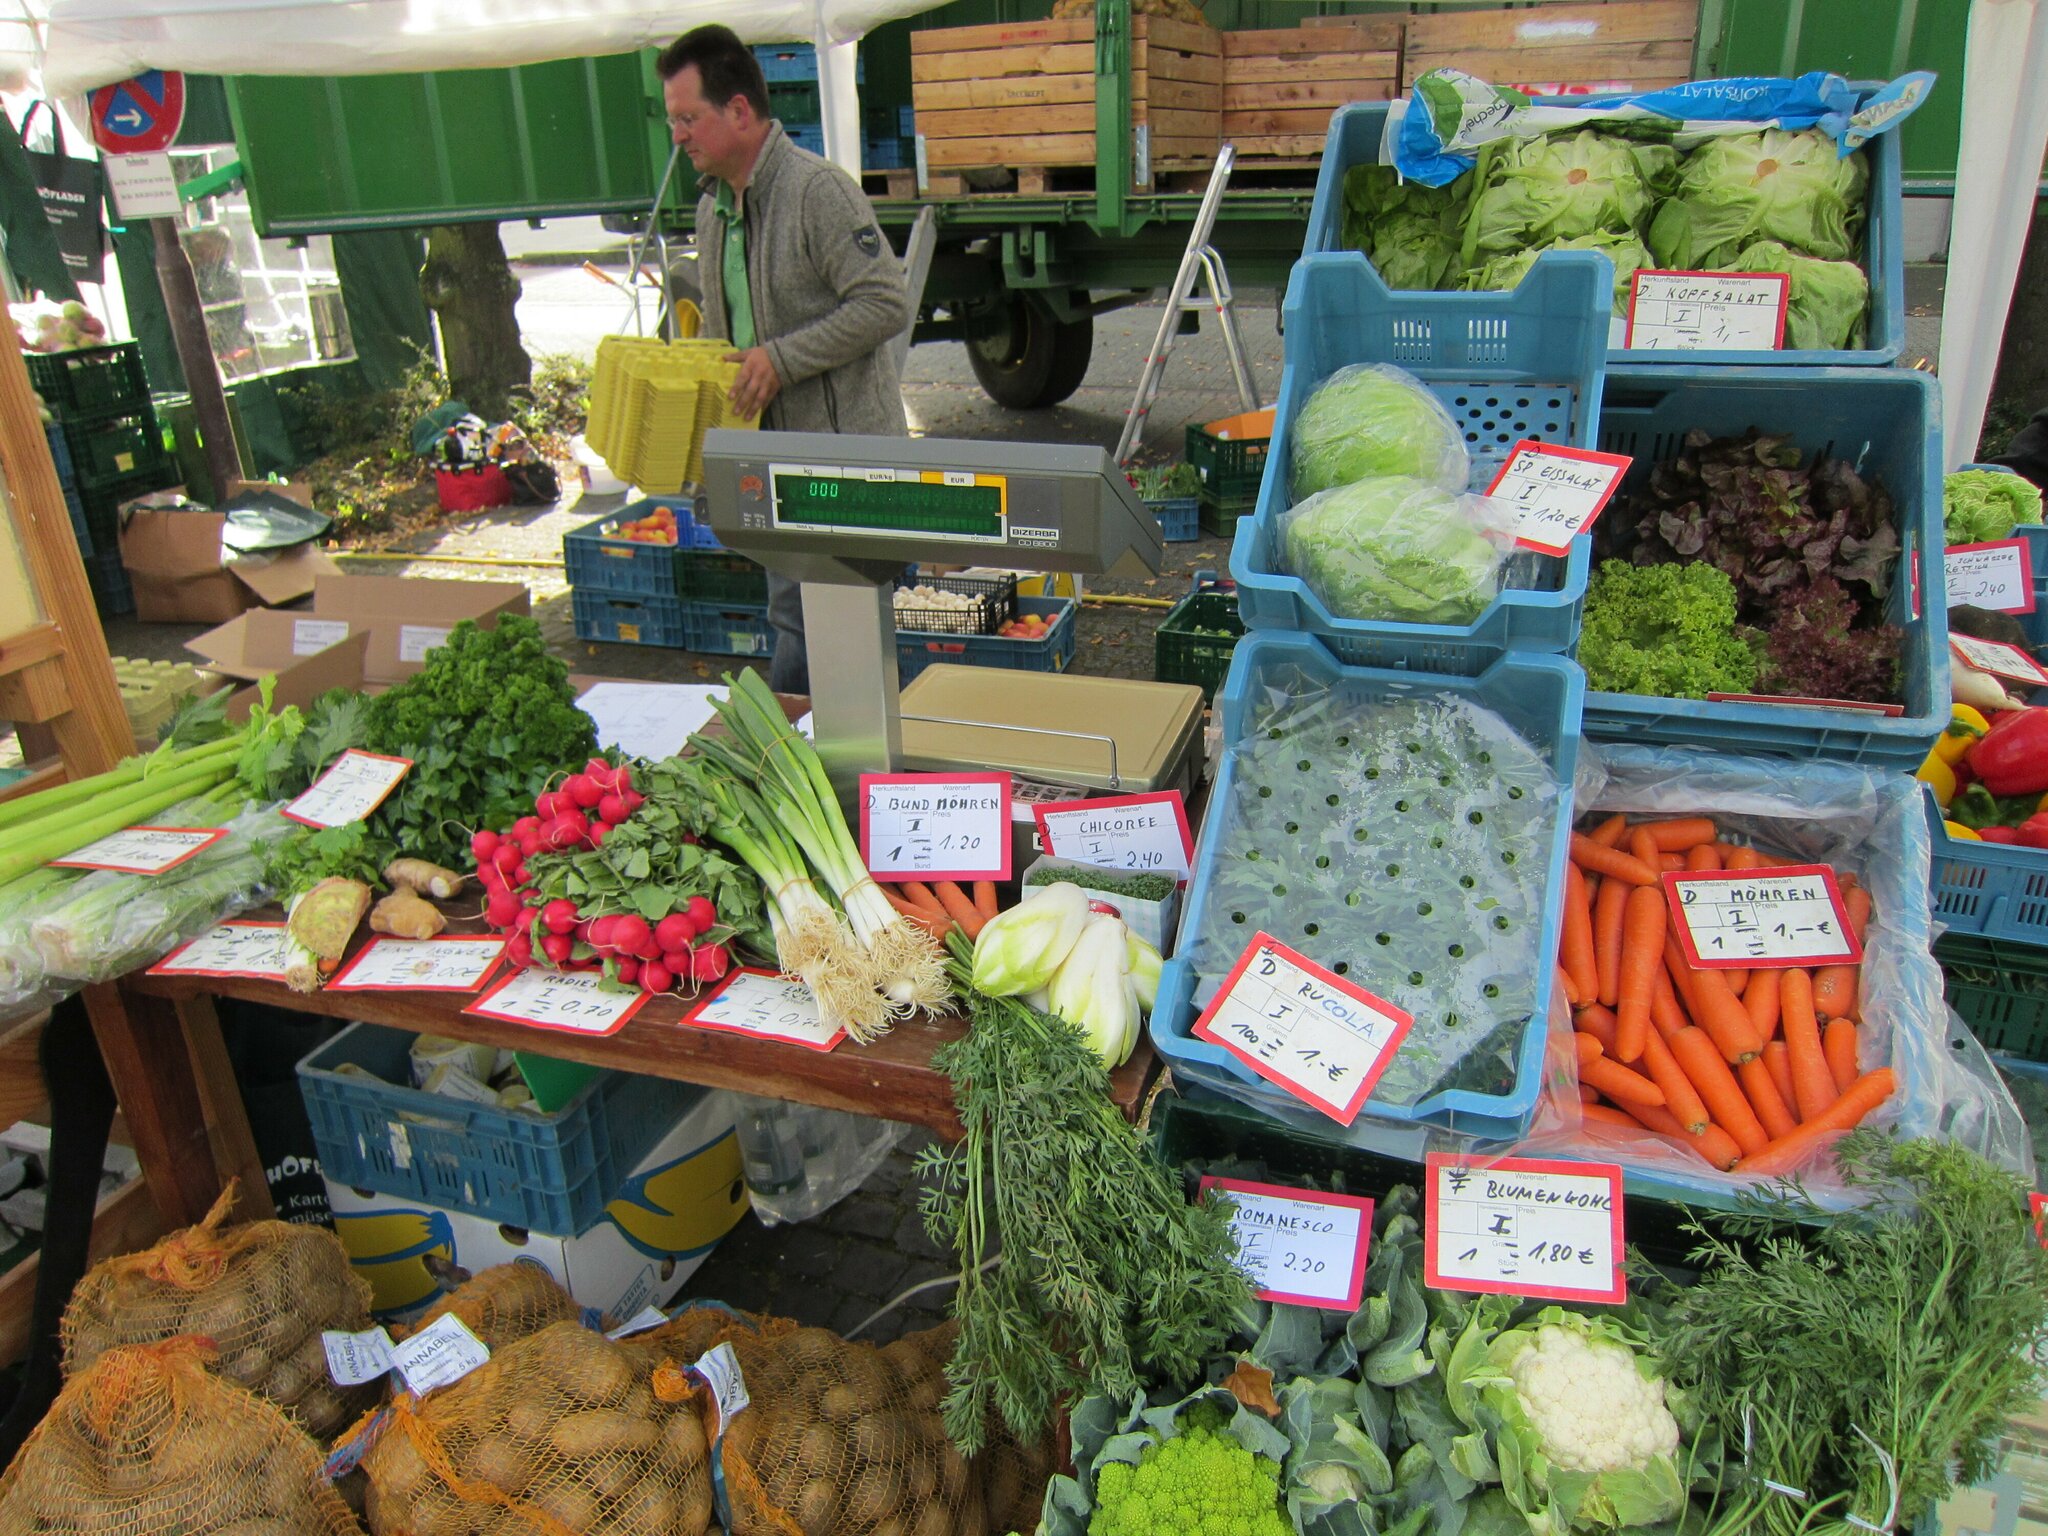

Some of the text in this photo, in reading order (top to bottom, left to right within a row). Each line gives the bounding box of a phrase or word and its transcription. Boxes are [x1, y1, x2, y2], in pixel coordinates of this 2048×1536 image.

[1640, 275, 1751, 287] Herkunftsland Warenart
[1666, 287, 1769, 305] KOPFSALAT
[1703, 304, 1726, 312] Preis
[803, 467, 813, 476] kg
[1514, 460, 1602, 490] SP EISSALAT
[809, 482, 838, 498] 000
[1012, 529, 1057, 538] BIZERBA
[889, 798, 930, 811] BUND
[937, 795, 999, 810] MÖHREN
[1046, 805, 1143, 820] Herkunftsland Warenart
[1080, 817, 1158, 834] CHICOREE
[886, 846, 902, 862] 1
[1127, 851, 1163, 869] 2,40
[1678, 877, 1793, 888] Herkunftsland Warenart
[1683, 889, 1697, 904] D
[1755, 902, 1778, 910] Preis
[1711, 936, 1723, 949] 1
[1260, 958, 1276, 975] D
[1298, 981, 1376, 1039] RUCOLA
[1231, 1022, 1260, 1044] 100
[1266, 1023, 1288, 1040] Gramm
[1515, 1173, 1548, 1181] Warenart
[1292, 1201, 1325, 1212] Warenart
[1518, 1207, 1536, 1215] Preis
[1276, 1228, 1298, 1237] Preis
[1458, 1248, 1478, 1261] 1
[1498, 1259, 1519, 1267] Stück
[404, 1331, 464, 1374] ANNABELL
[459, 1362, 467, 1372] 5
[466, 1355, 478, 1368] kg
